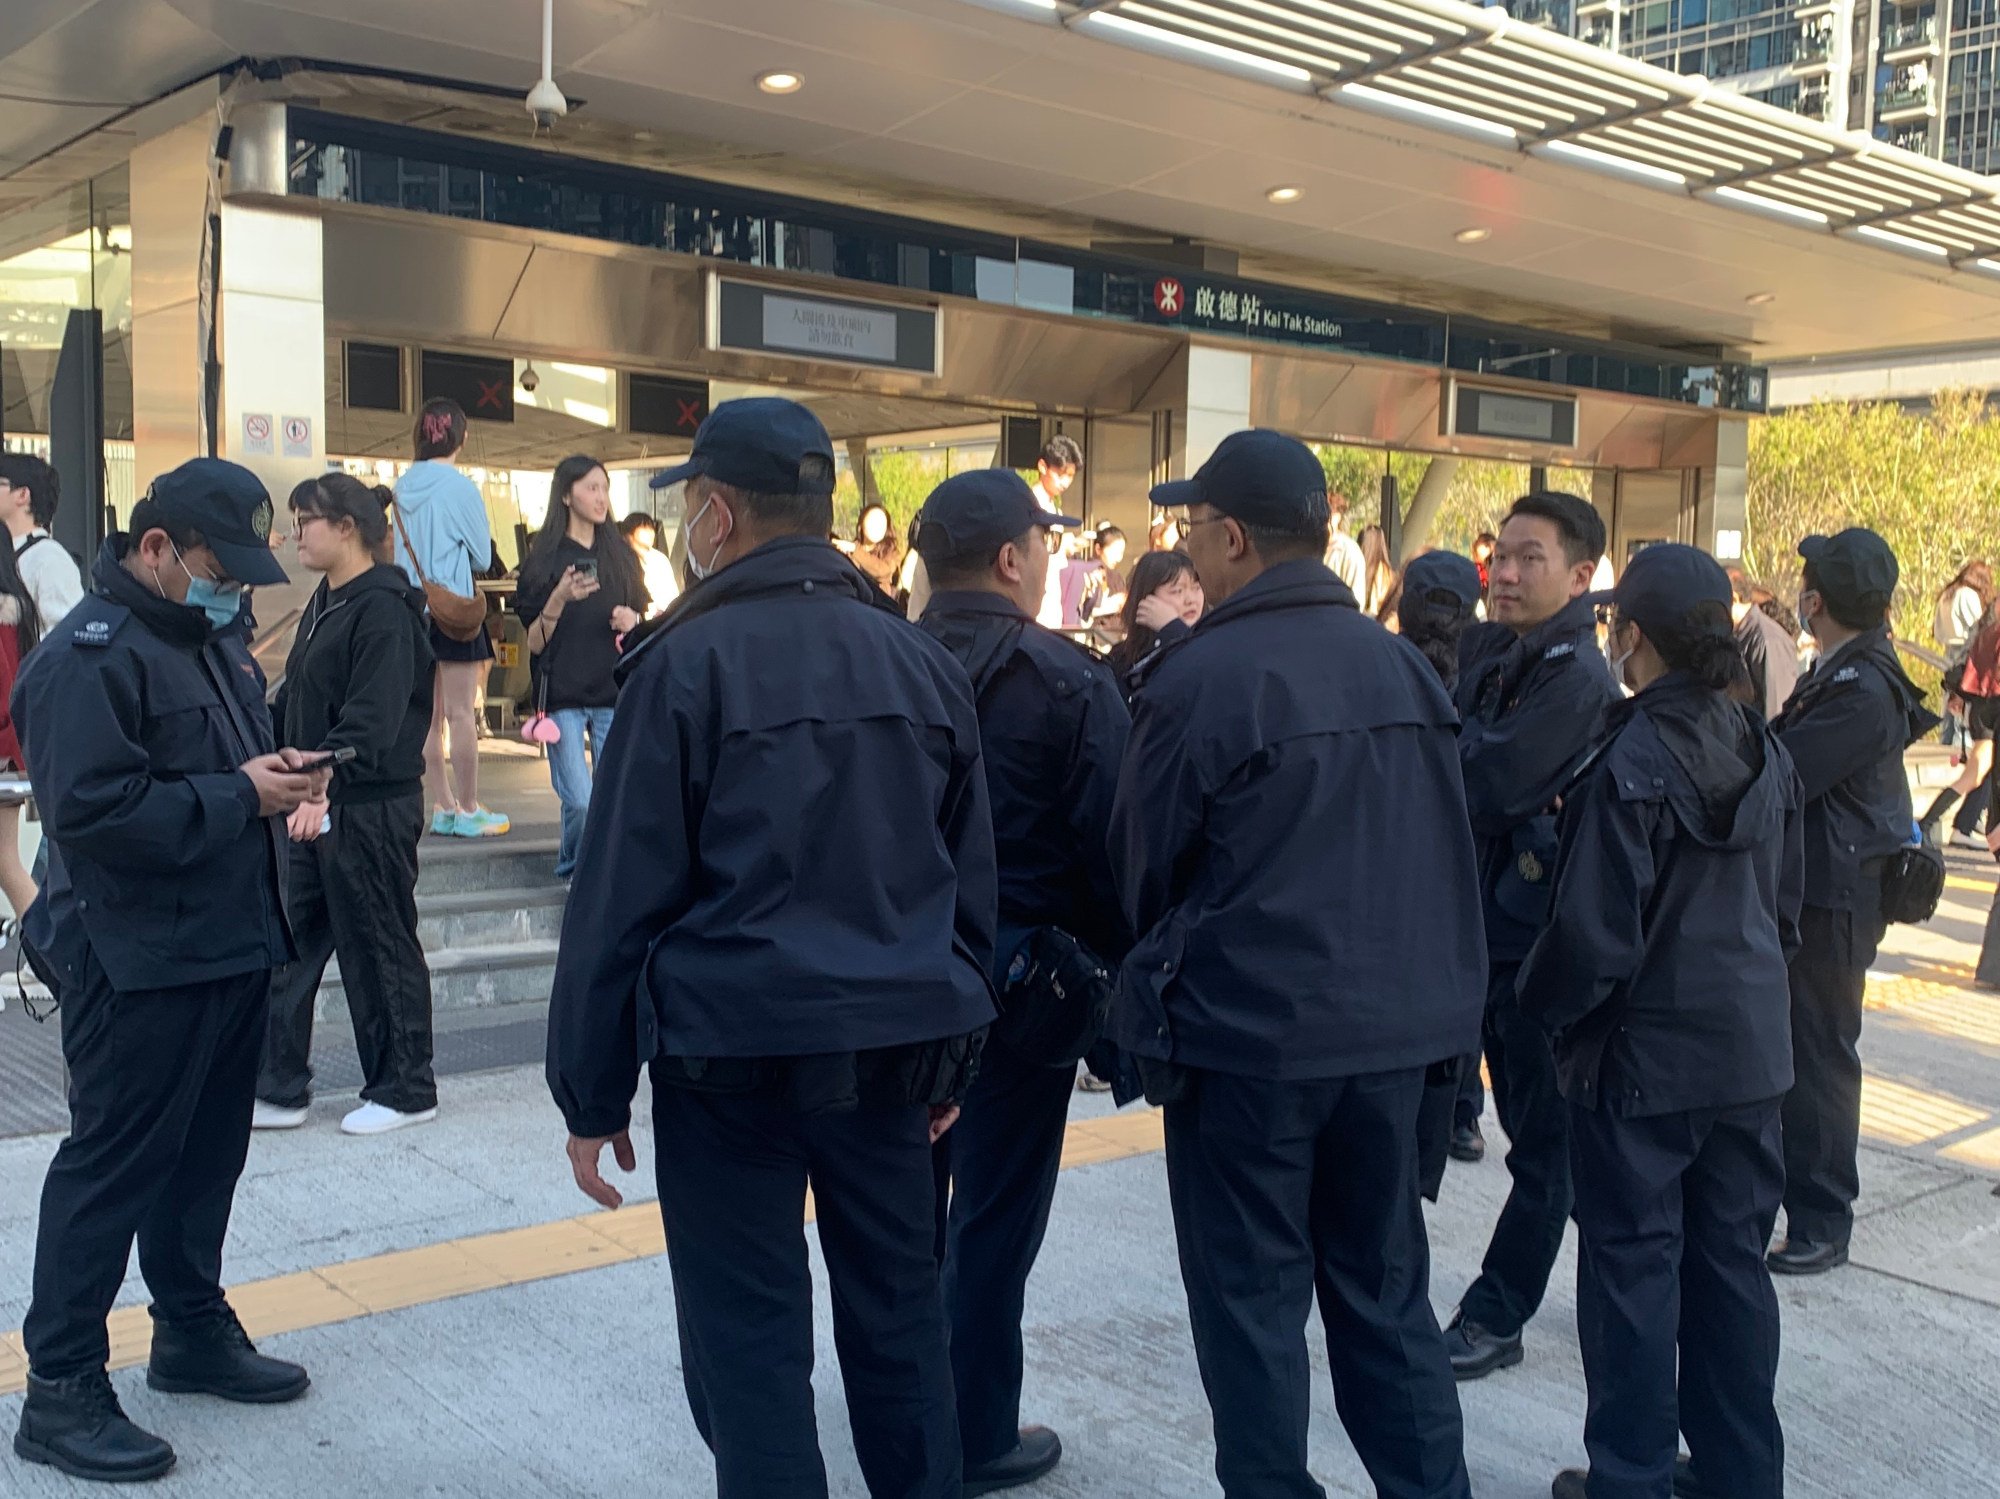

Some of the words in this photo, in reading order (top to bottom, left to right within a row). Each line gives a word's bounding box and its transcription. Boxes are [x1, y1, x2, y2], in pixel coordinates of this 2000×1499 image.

[1263, 309, 1281, 328] Kai
[1283, 312, 1303, 332] Tak
[1304, 315, 1342, 338] Station
[1751, 380, 1760, 399] D
